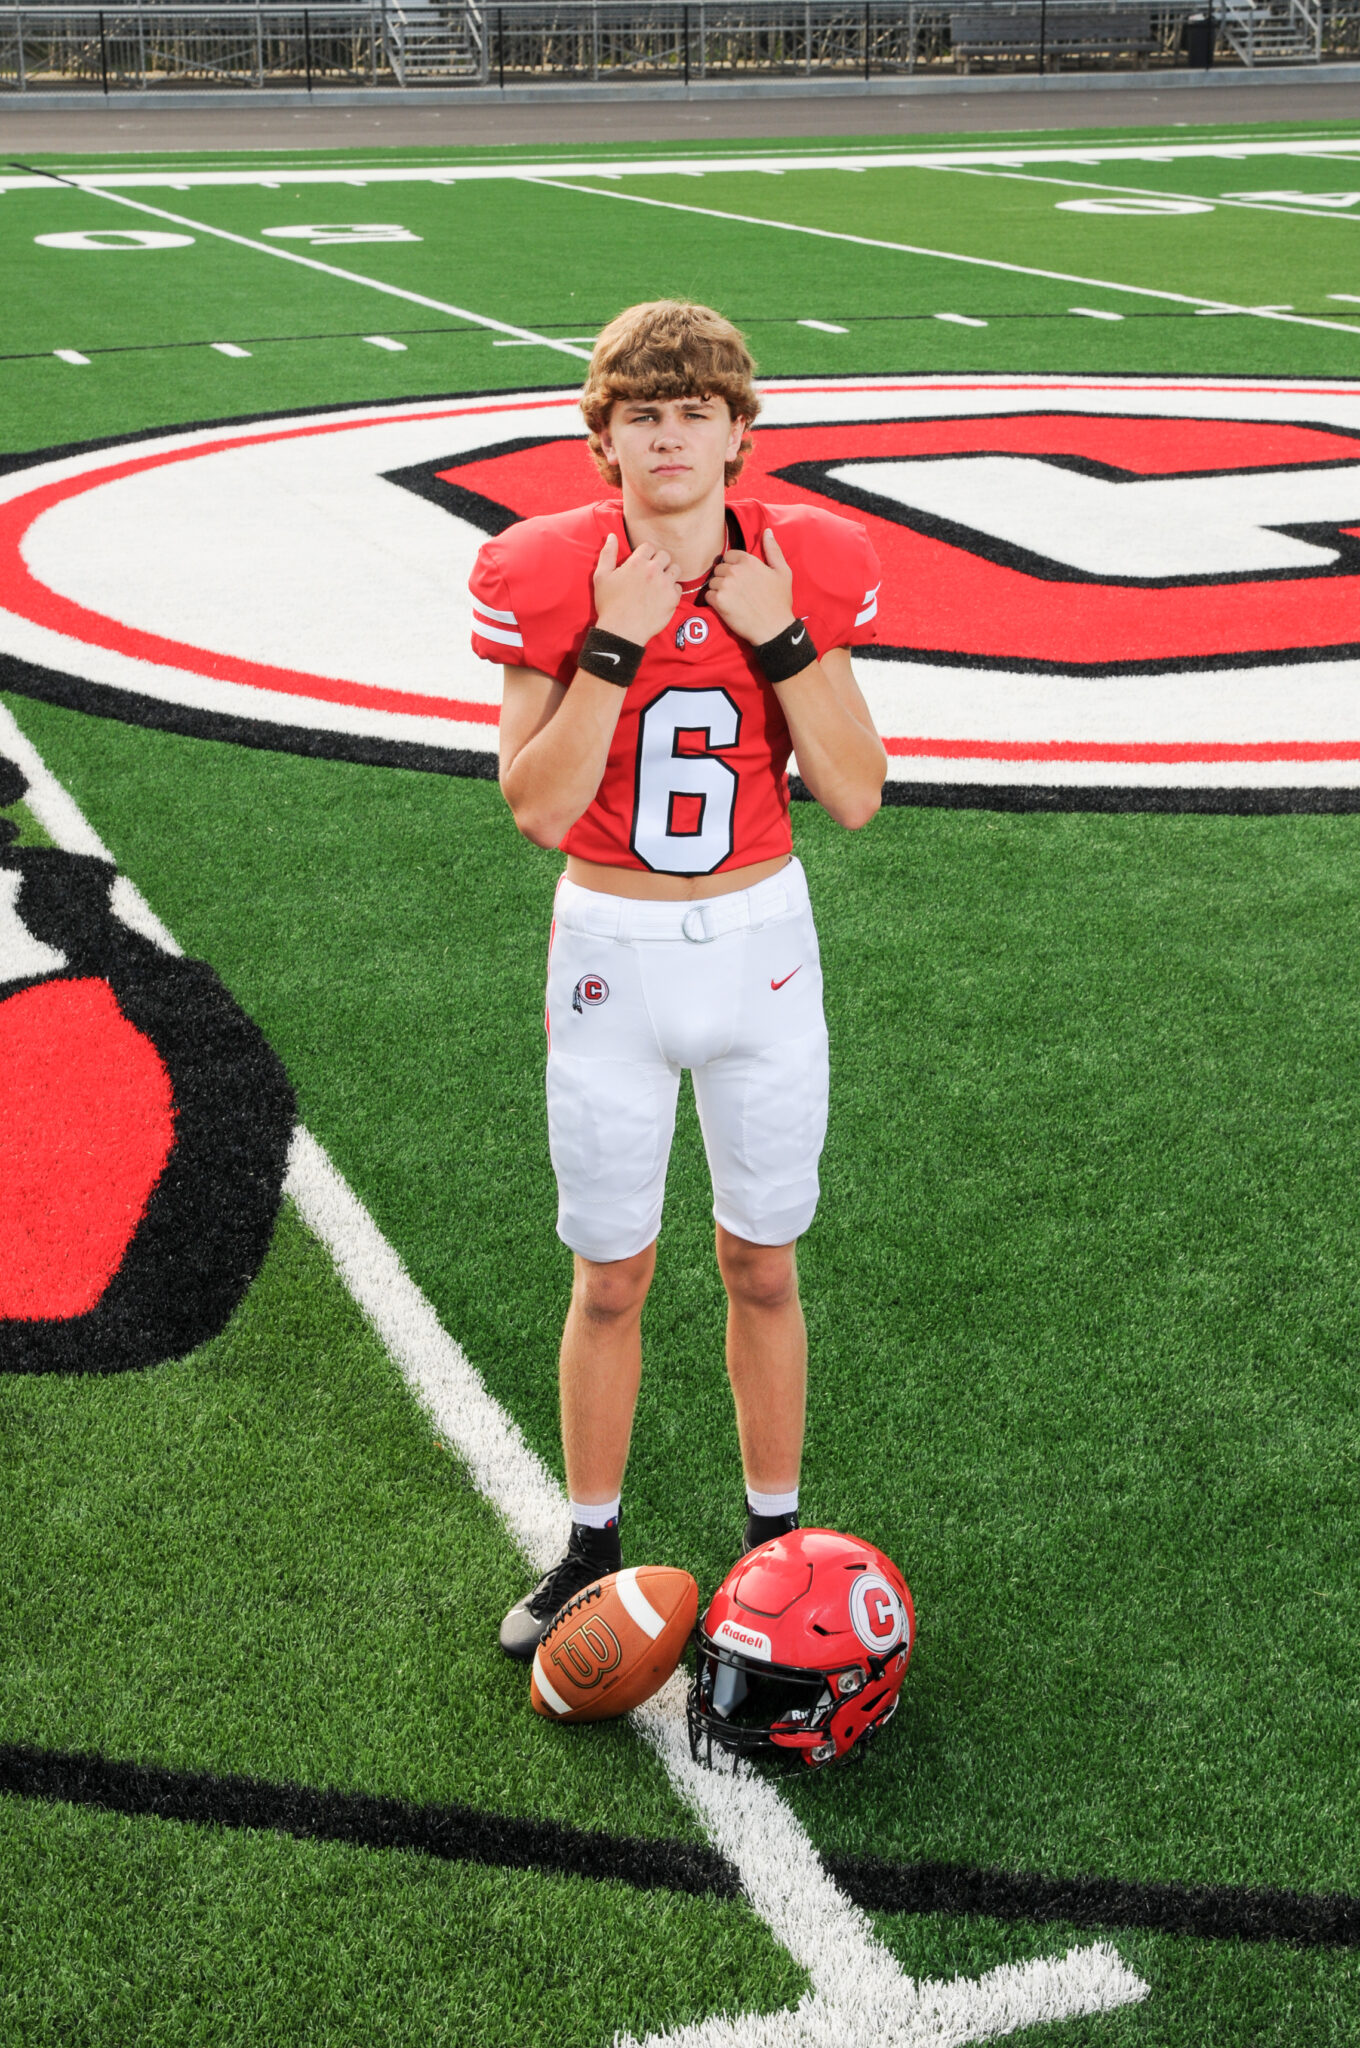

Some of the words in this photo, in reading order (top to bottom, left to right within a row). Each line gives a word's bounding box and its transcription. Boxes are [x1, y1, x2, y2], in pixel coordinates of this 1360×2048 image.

[689, 621, 703, 639] C
[629, 686, 743, 878] 6
[585, 980, 602, 1000] C
[863, 1587, 895, 1638] C
[721, 1623, 764, 1649] Riddell
